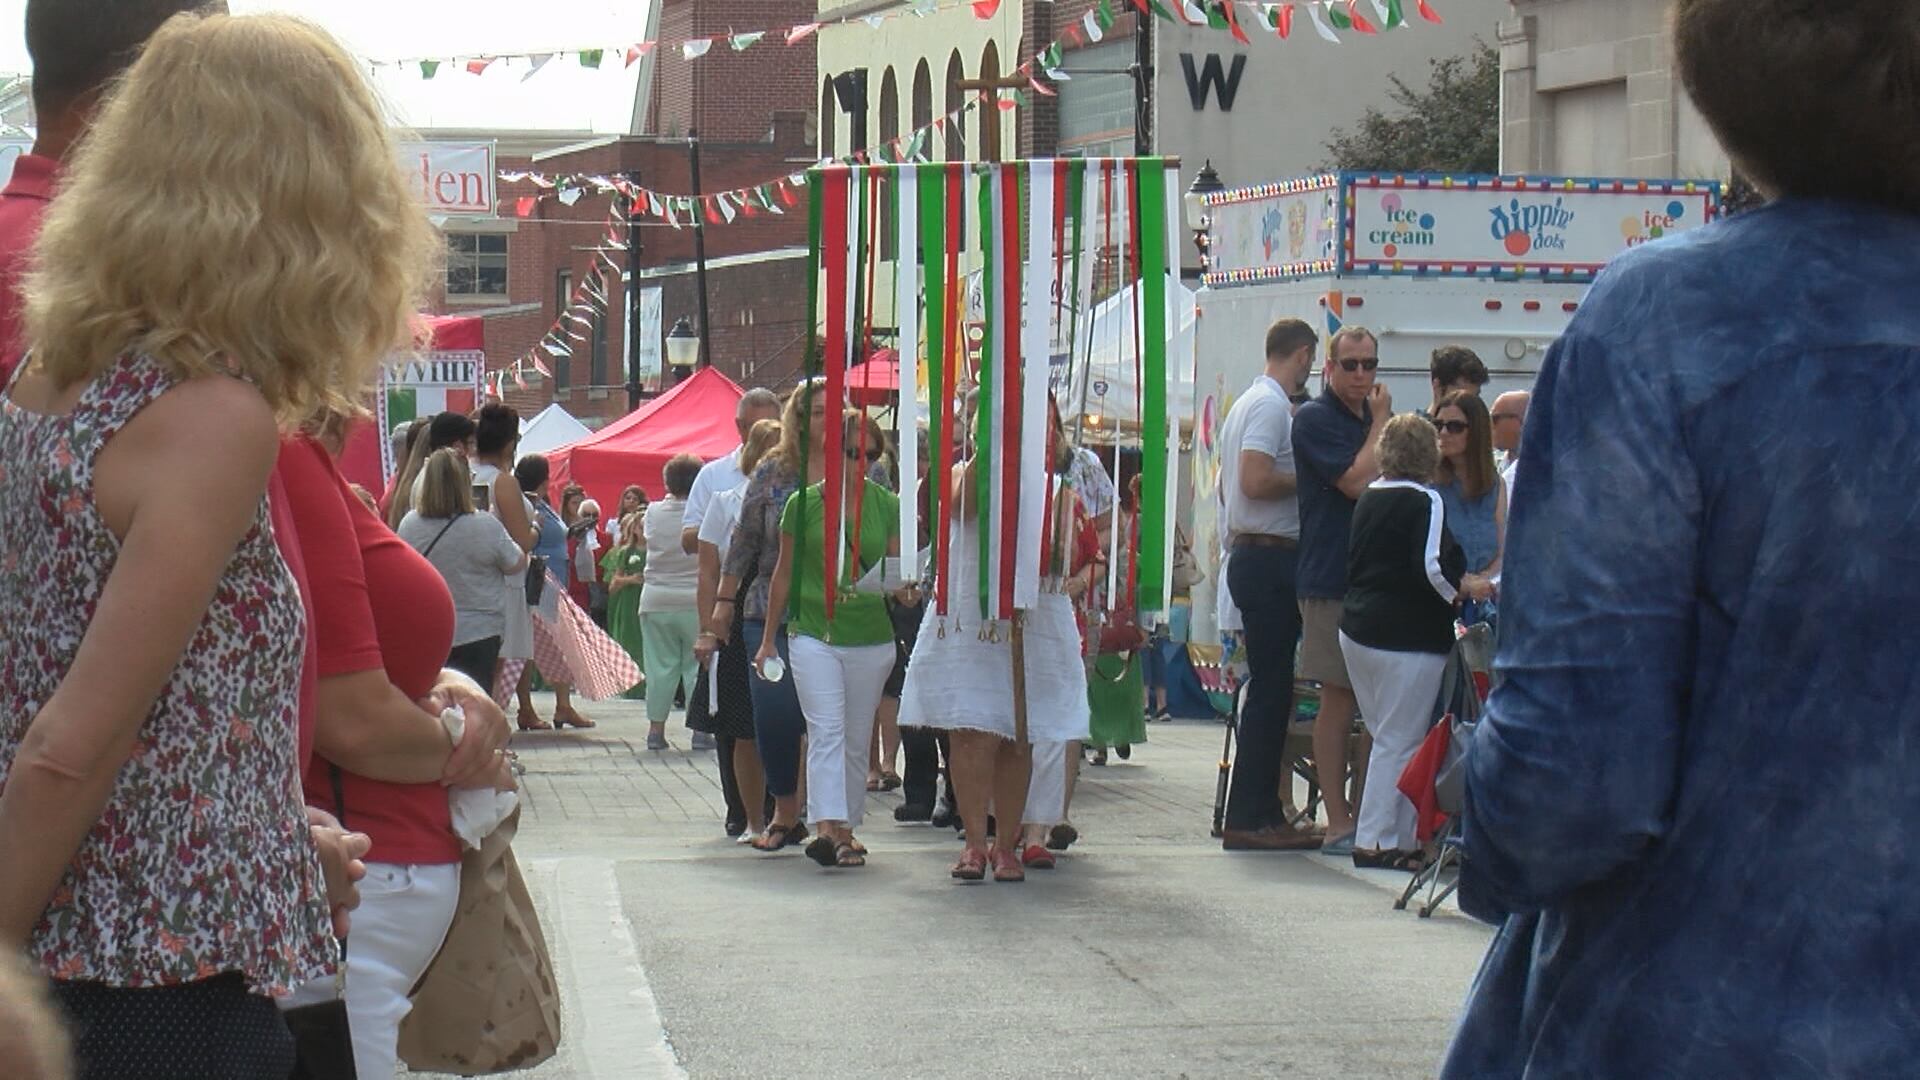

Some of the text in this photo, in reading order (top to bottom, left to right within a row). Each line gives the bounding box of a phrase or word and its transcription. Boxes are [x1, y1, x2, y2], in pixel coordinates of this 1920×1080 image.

[1179, 53, 1247, 112] W
[1387, 204, 1418, 224] ice
[1644, 210, 1675, 228] ice
[1369, 227, 1435, 246] cream
[1532, 231, 1566, 250] dots
